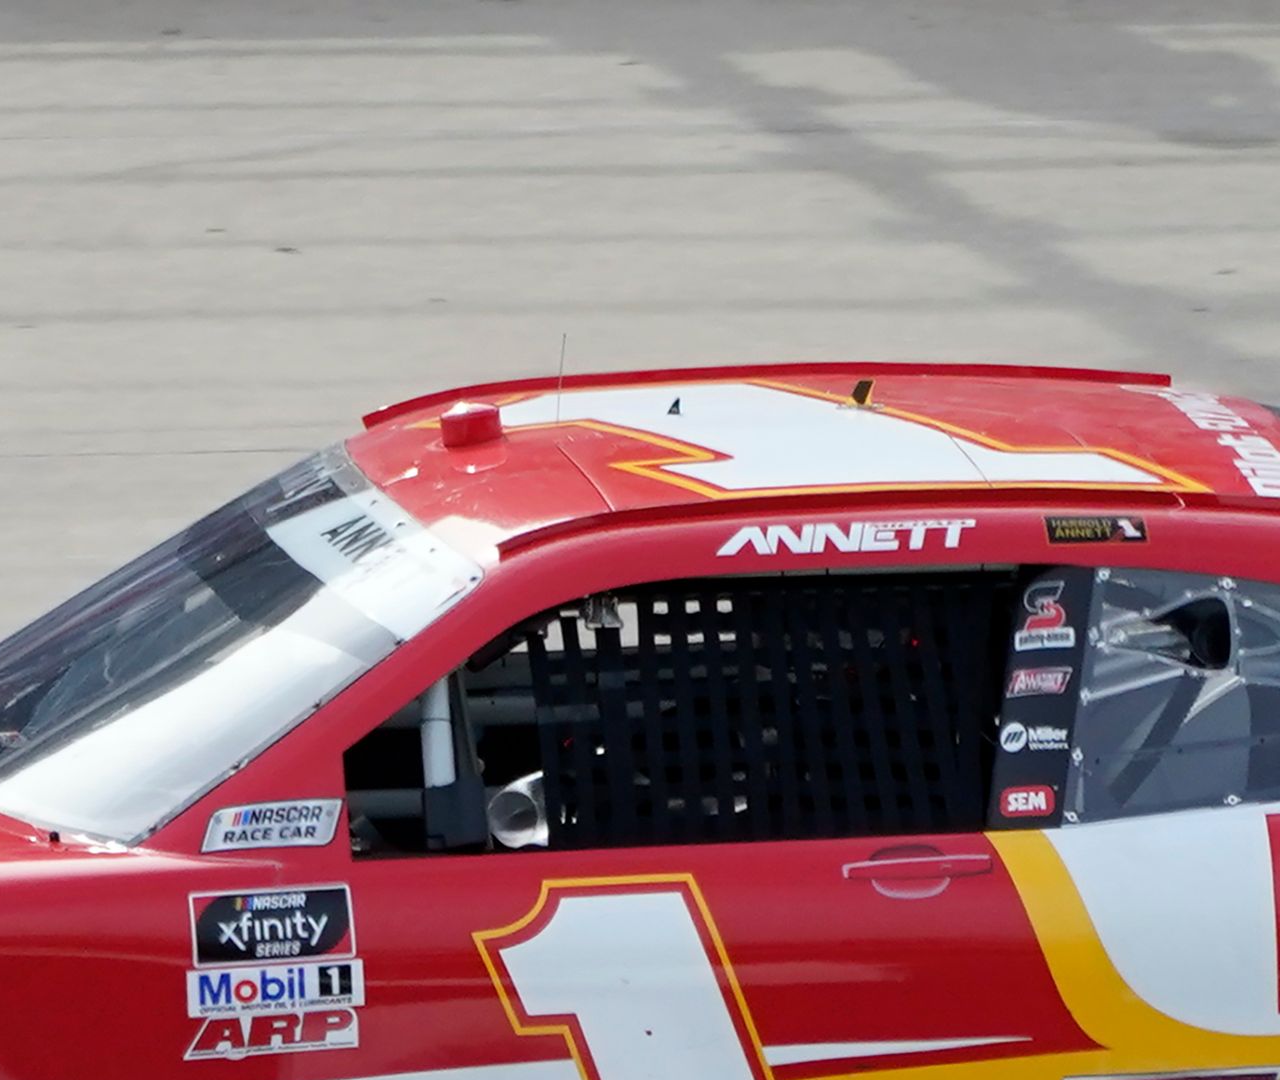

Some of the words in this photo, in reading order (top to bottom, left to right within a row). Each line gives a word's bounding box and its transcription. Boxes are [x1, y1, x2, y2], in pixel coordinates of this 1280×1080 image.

[716, 519, 976, 556] ANNETT
[1117, 518, 1142, 538] 1
[1007, 791, 1047, 812] SEM
[249, 805, 323, 826] NASCAR
[223, 826, 272, 843] RACE
[279, 825, 317, 840] CAR
[252, 893, 307, 911] NASCAR
[218, 910, 328, 951] xfinity
[255, 940, 302, 958] SERIES
[198, 967, 305, 1006] Mobil
[193, 1009, 354, 1051] ARP
